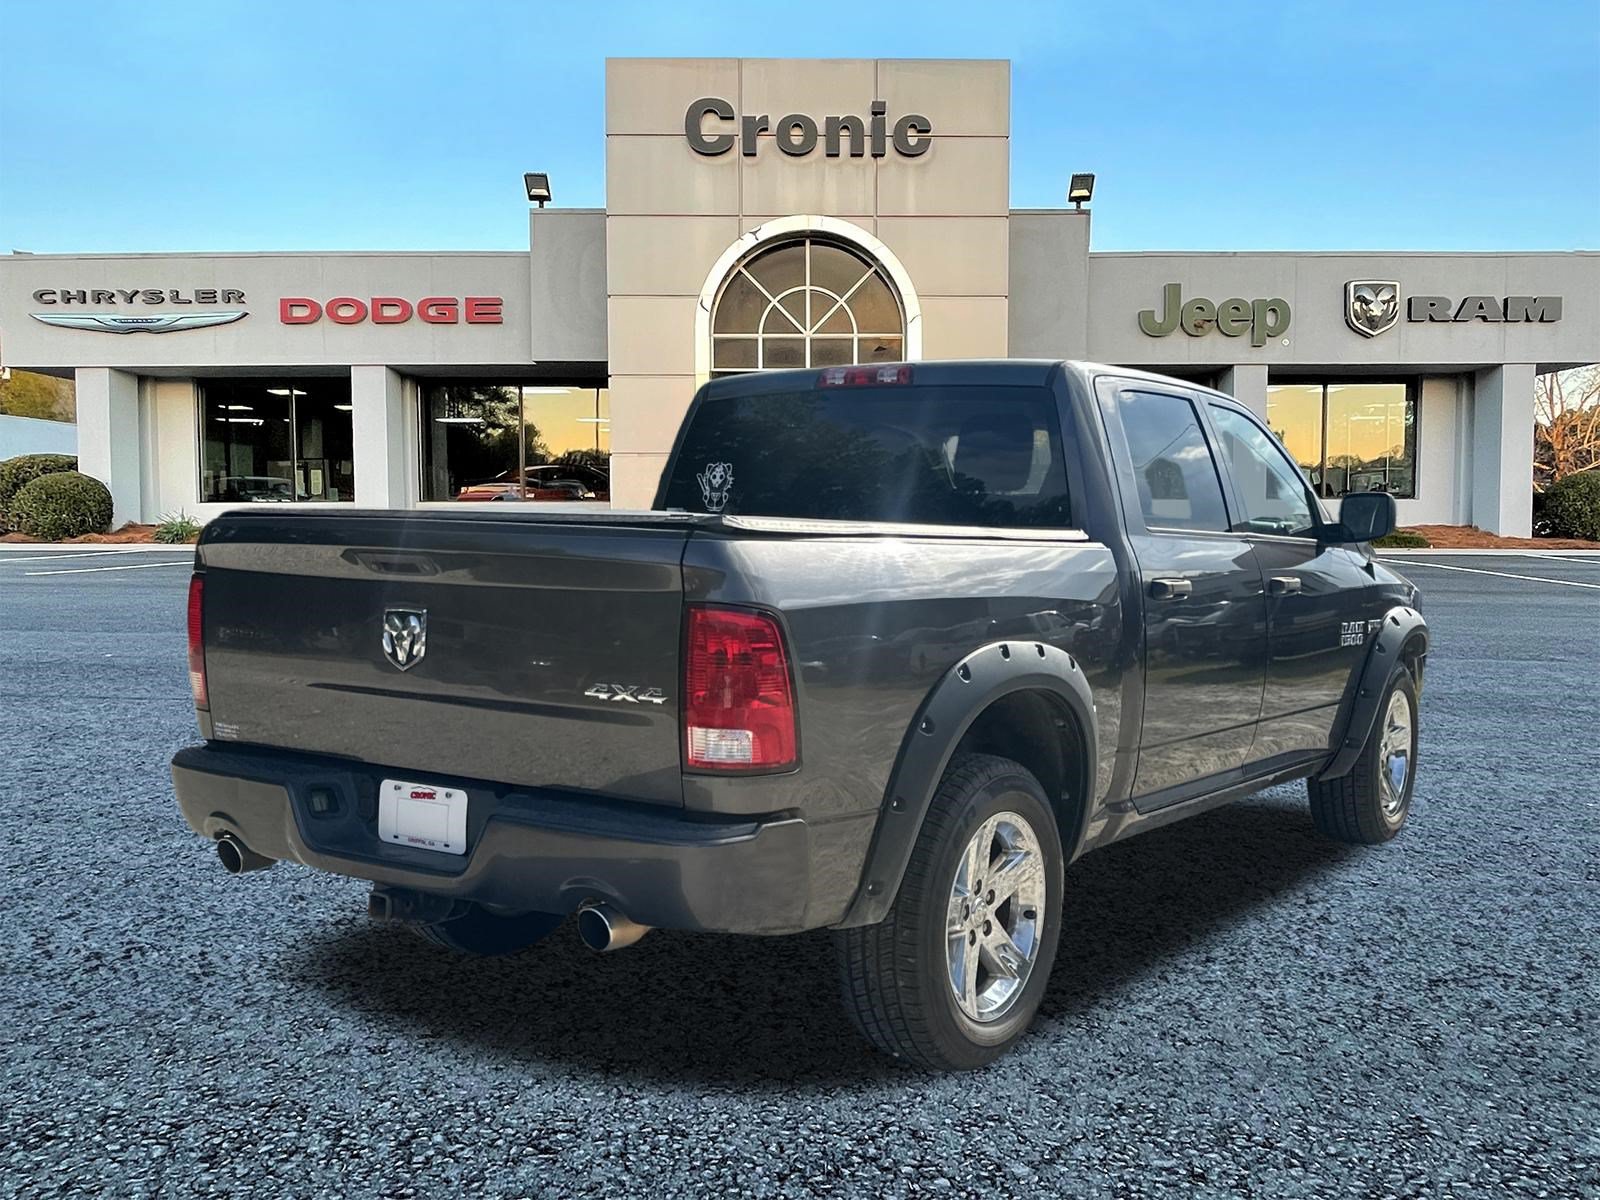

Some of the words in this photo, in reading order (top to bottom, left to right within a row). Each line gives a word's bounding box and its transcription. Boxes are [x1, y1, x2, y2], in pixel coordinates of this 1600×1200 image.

[685, 97, 932, 157] Cronic
[32, 289, 247, 305] CHRYSLER
[280, 296, 503, 325] DODGE
[1407, 296, 1562, 323] RAM
[1137, 282, 1291, 347] Jeep
